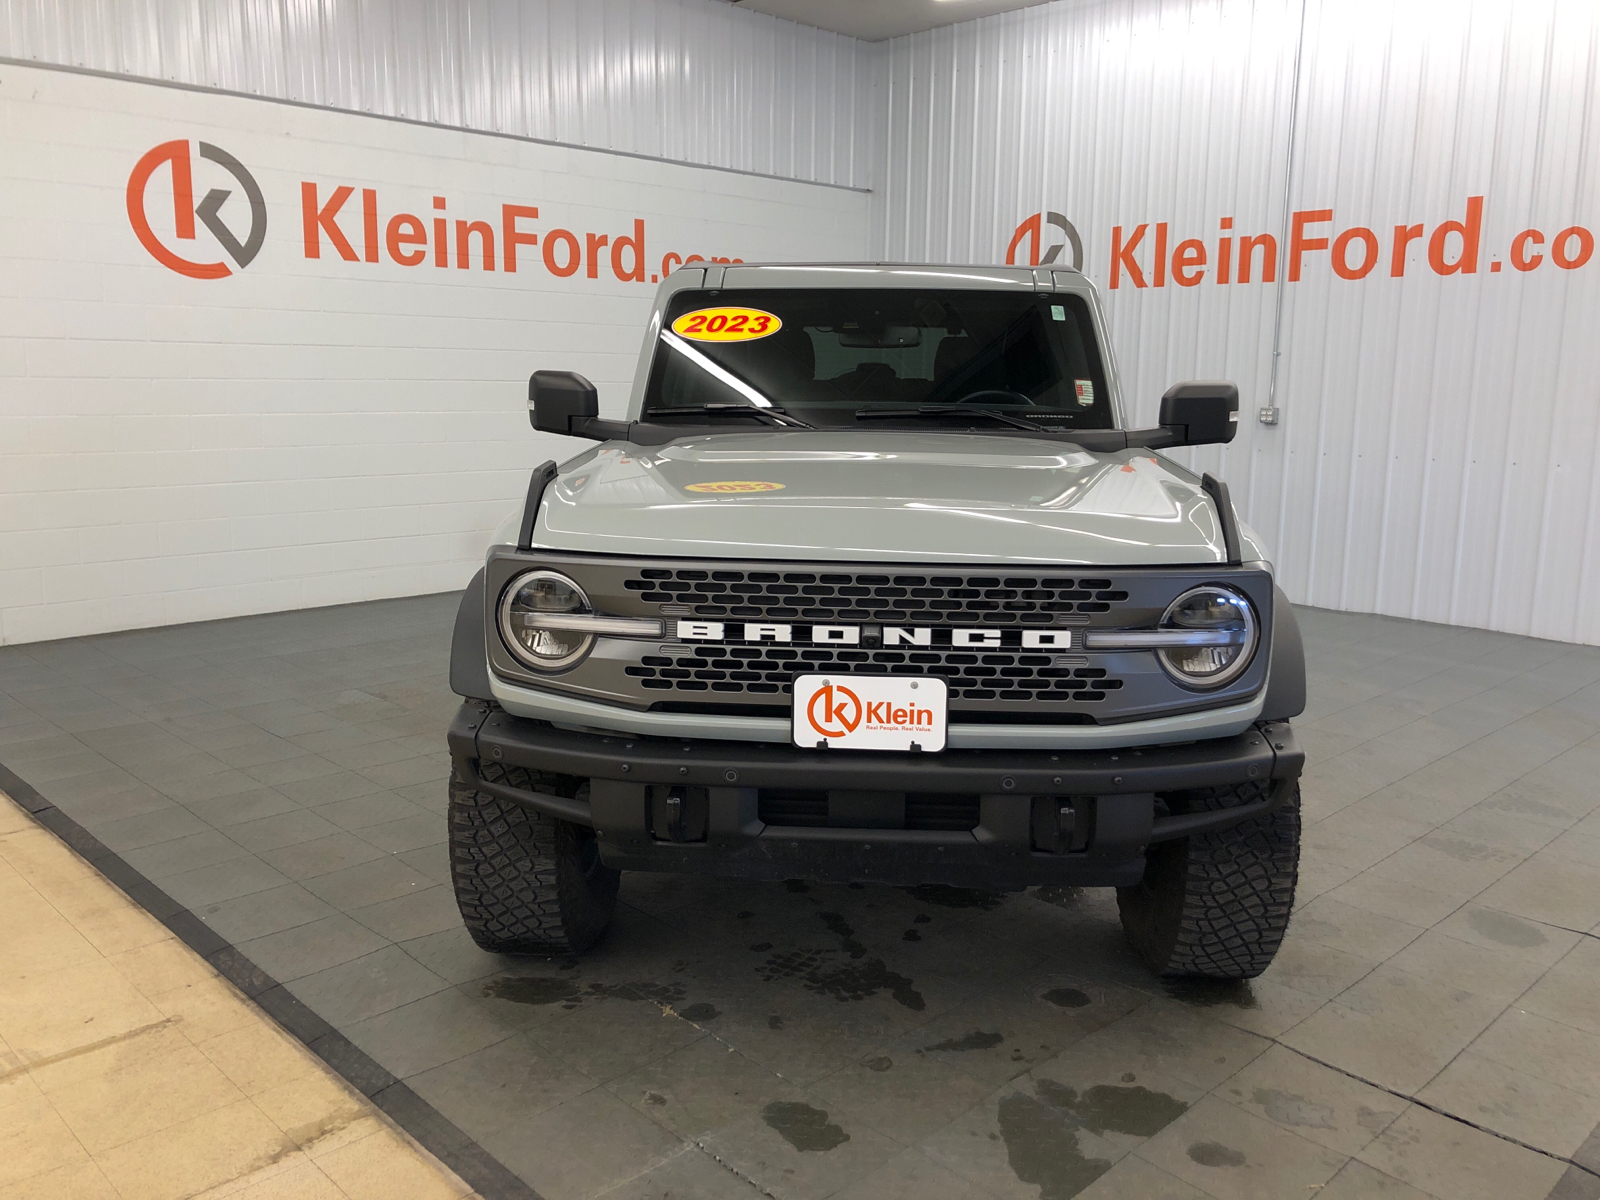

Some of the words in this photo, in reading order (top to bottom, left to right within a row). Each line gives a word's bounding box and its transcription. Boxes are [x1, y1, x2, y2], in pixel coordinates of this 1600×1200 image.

[300, 181, 744, 284] KleinFord.c
[682, 315, 772, 334] 2023
[676, 620, 1072, 649] BRONCO
[866, 701, 933, 726] Klein
